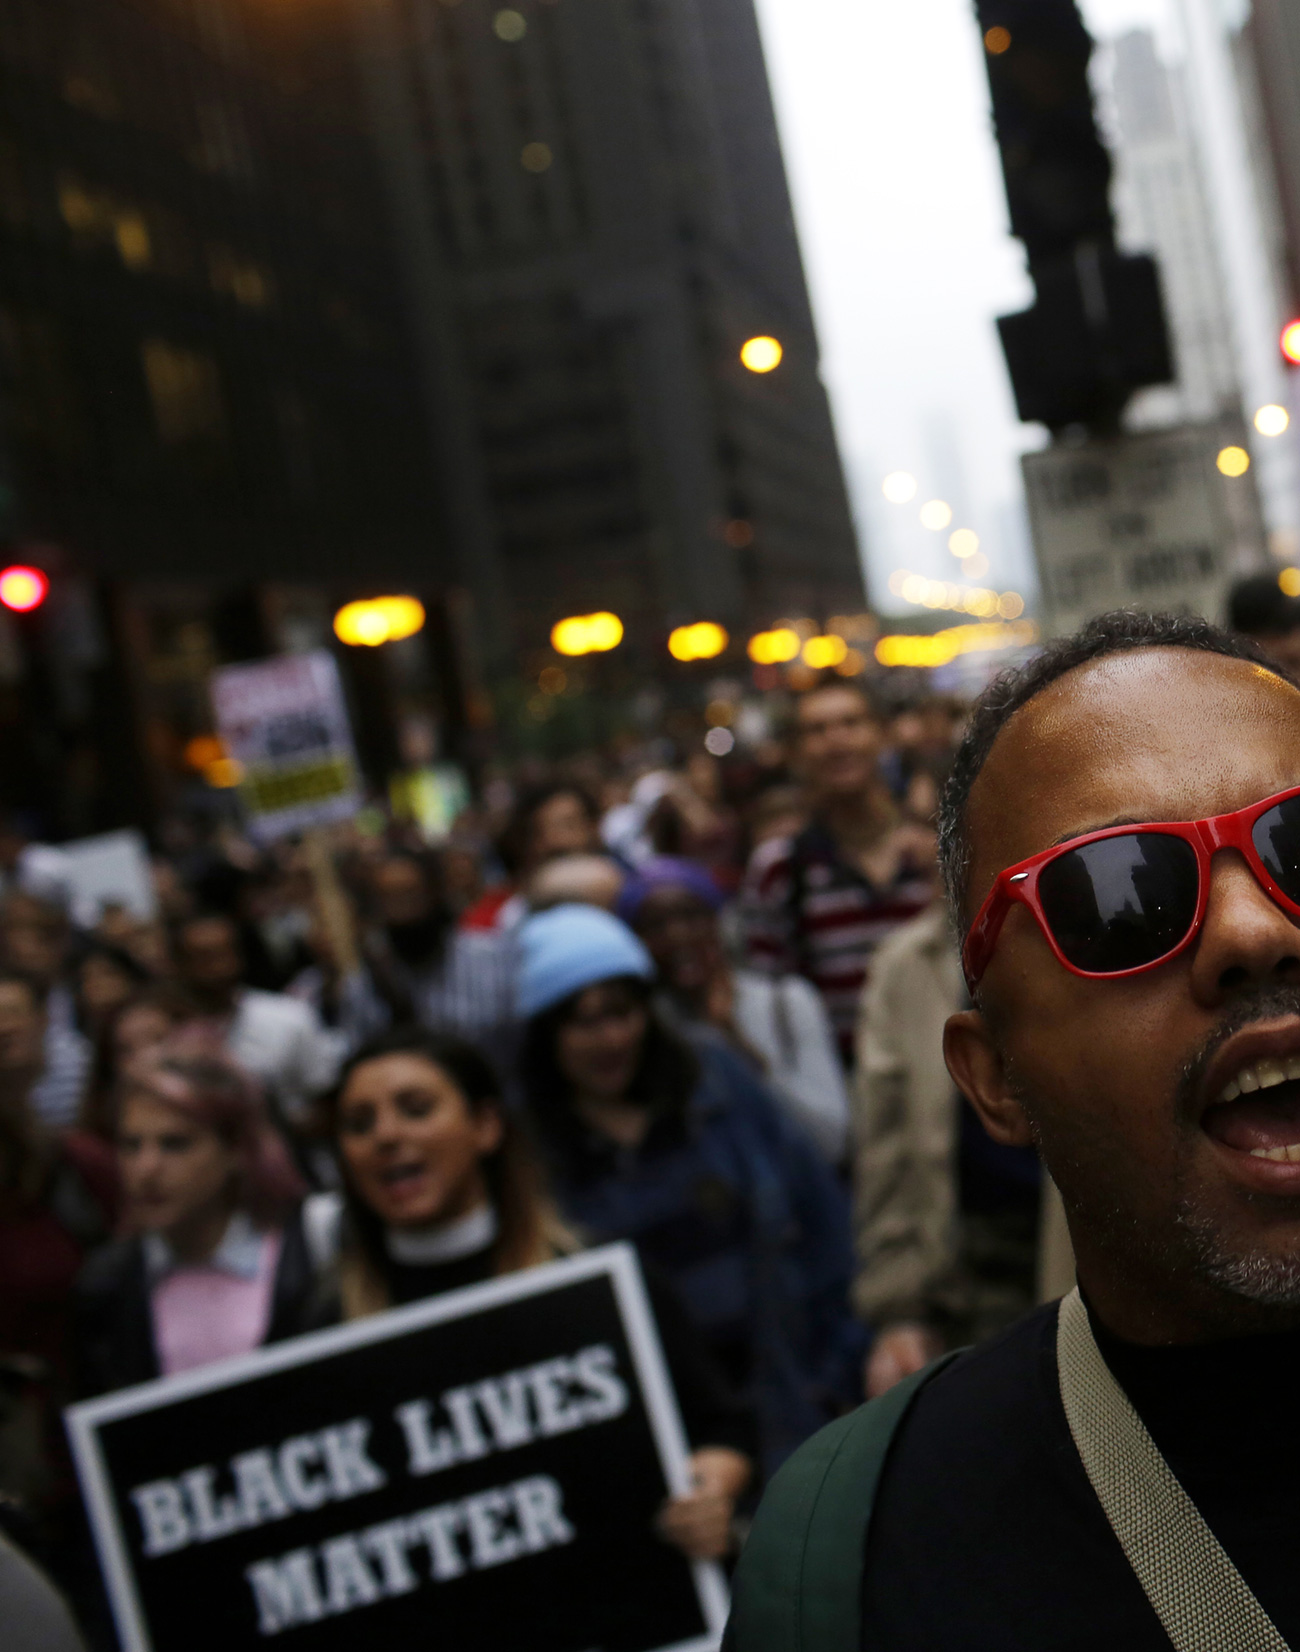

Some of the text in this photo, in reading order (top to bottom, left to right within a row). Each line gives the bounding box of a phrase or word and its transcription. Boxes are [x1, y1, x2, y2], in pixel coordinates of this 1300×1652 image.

[131, 1345, 630, 1557] BLACK LIVES
[245, 1474, 575, 1637] MATTER
